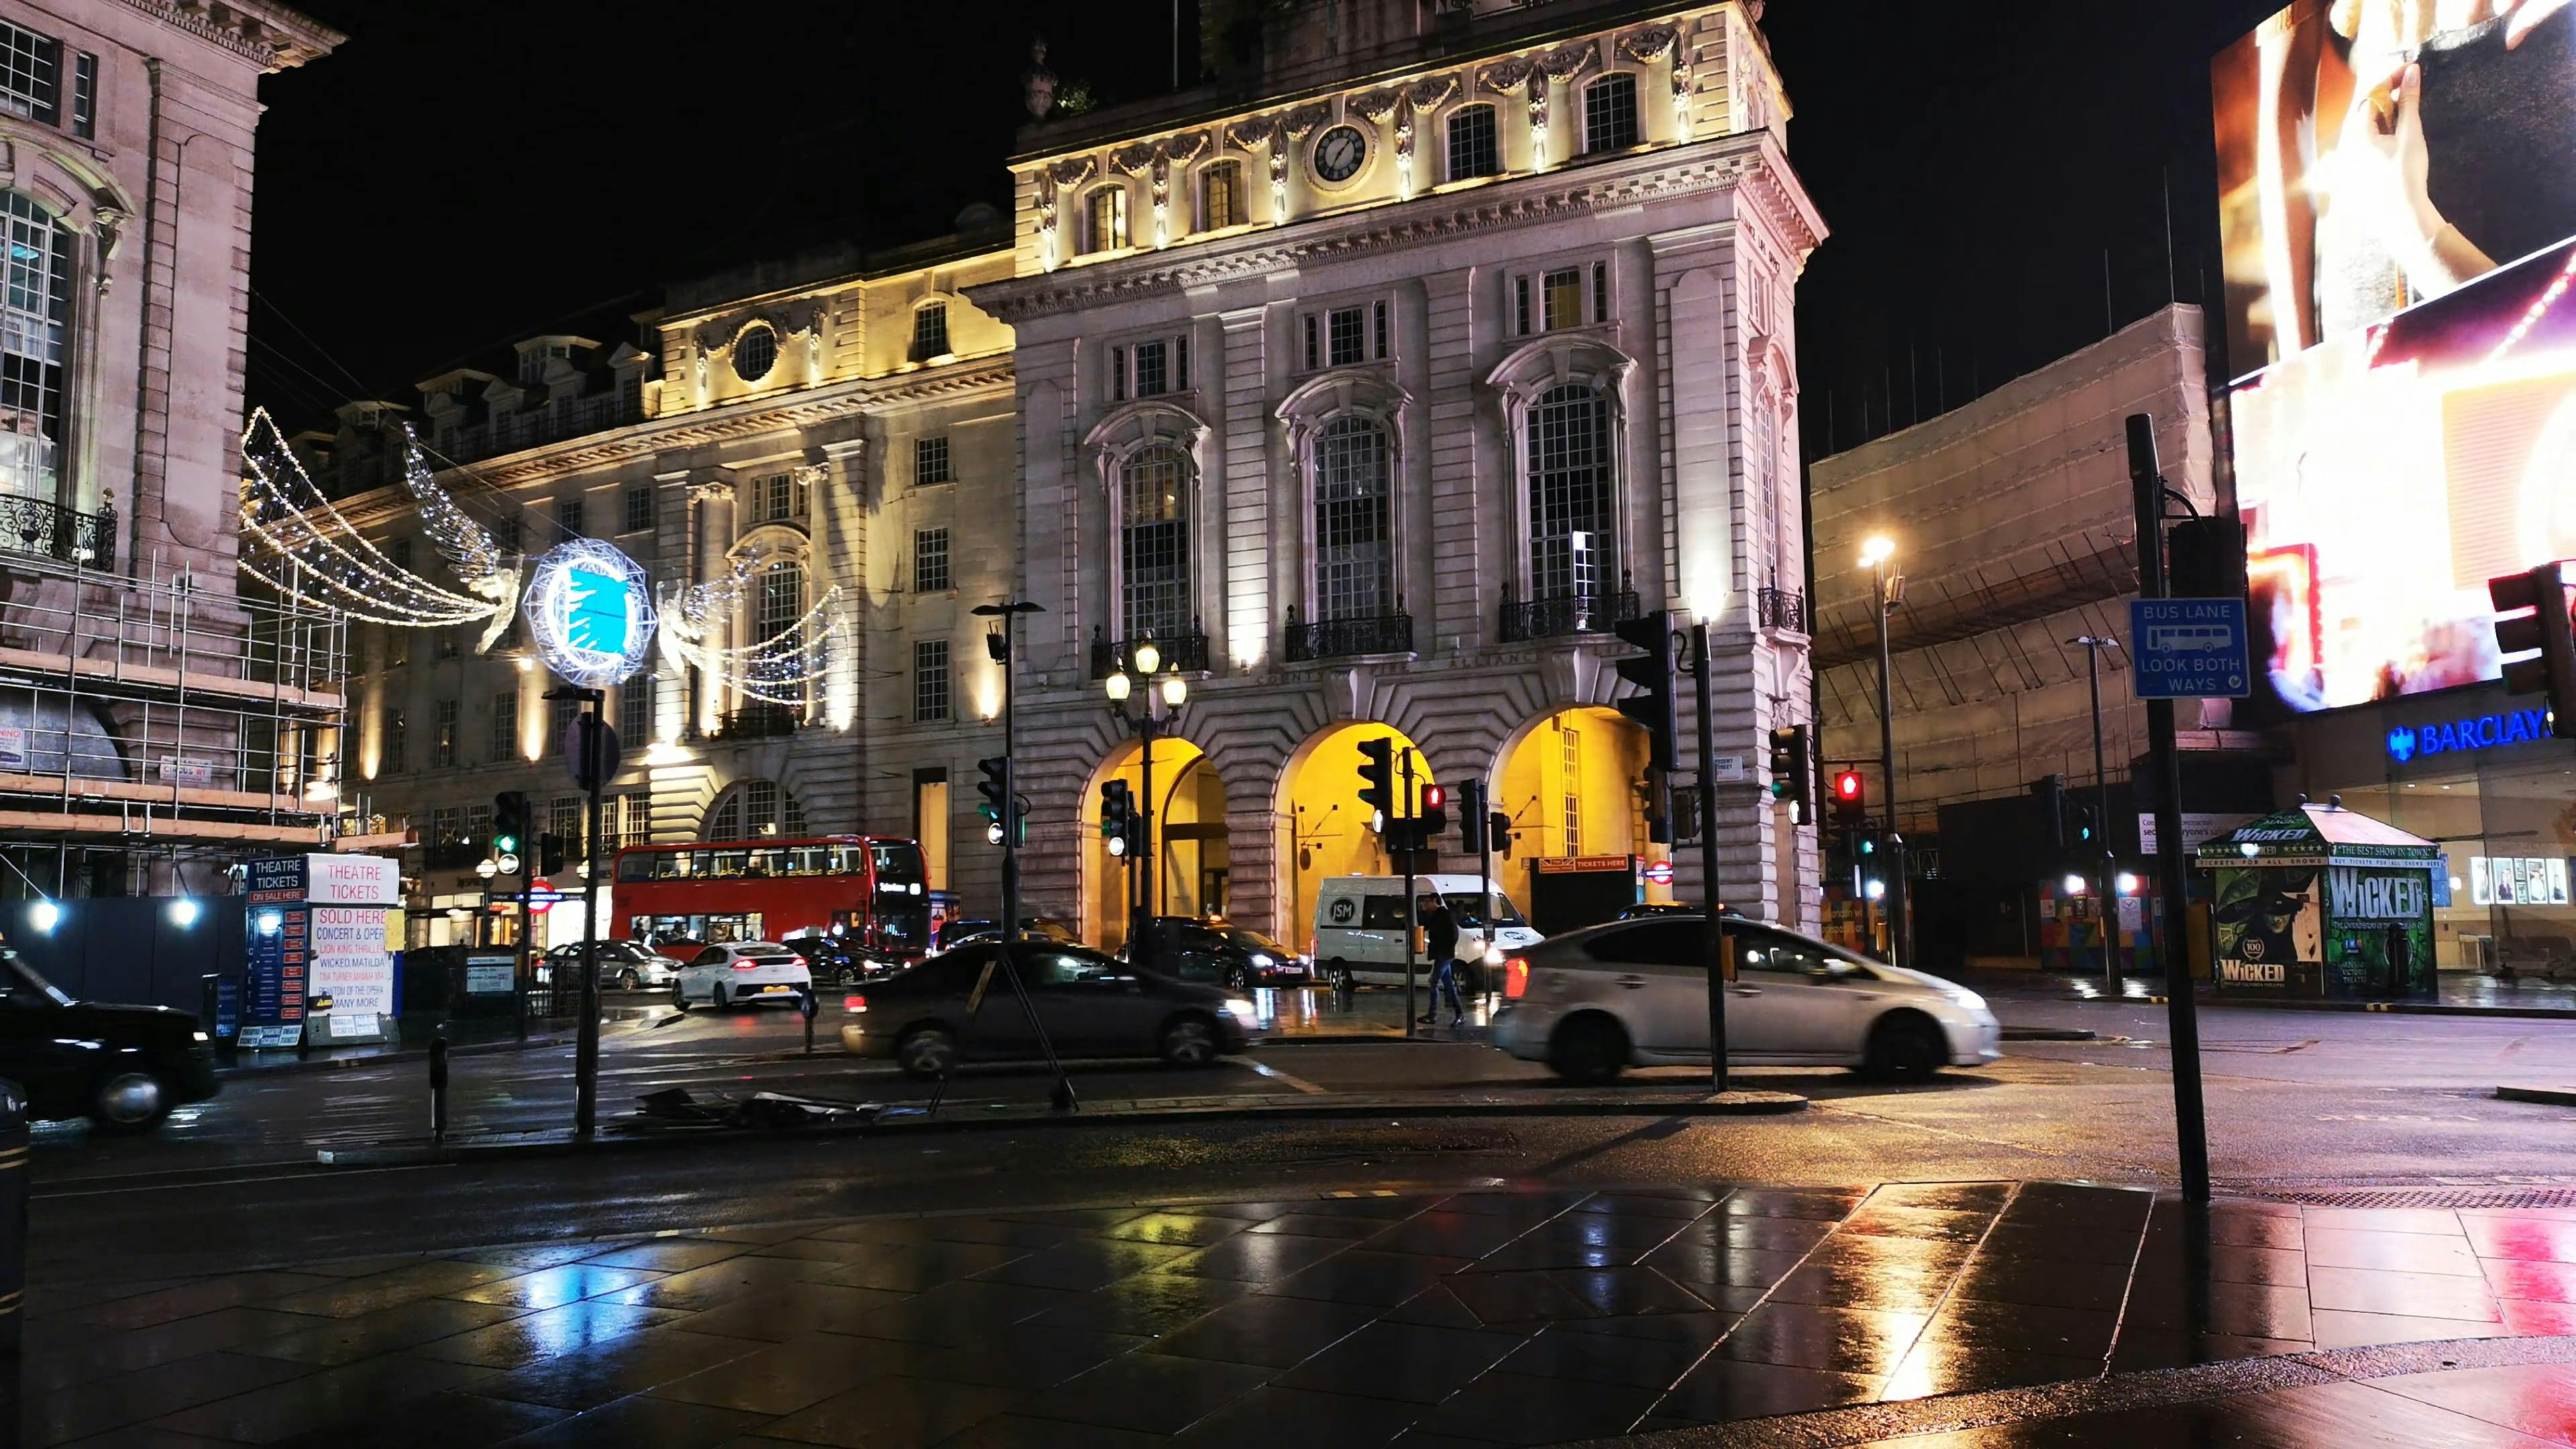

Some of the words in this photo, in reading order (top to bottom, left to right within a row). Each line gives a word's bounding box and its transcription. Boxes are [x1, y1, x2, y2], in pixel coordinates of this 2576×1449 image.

[2144, 606, 2179, 619] BUS
[2186, 605, 2231, 618] LANE
[2142, 659, 2189, 672] LOOK
[2194, 659, 2240, 671] BOTH
[2169, 678, 2216, 691] WAYS
[2421, 708, 2551, 755] BARCLAY
[2357, 846, 2373, 855] BEST
[2375, 847, 2396, 856] SHOW
[2398, 848, 2406, 856] IN
[255, 859, 301, 873] THEATRE
[328, 864, 382, 881] THEATRE
[256, 875, 299, 889] TICKETS
[253, 893, 264, 901] ON
[264, 892, 282, 900] SALE
[282, 891, 301, 900] HERE
[331, 884, 379, 900] TICKETS
[320, 909, 352, 924] SOLD
[356, 910, 386, 924] HERE
[317, 927, 354, 940] CONCERT
[356, 928, 362, 940] &
[364, 928, 384, 940] OPER
[320, 944, 335, 953] LION
[2246, 943, 2261, 951] 100
[347, 987, 354, 996] OF
[355, 986, 365, 996] THE
[333, 998, 356, 1008] MANY
[356, 998, 379, 1008] MORE
